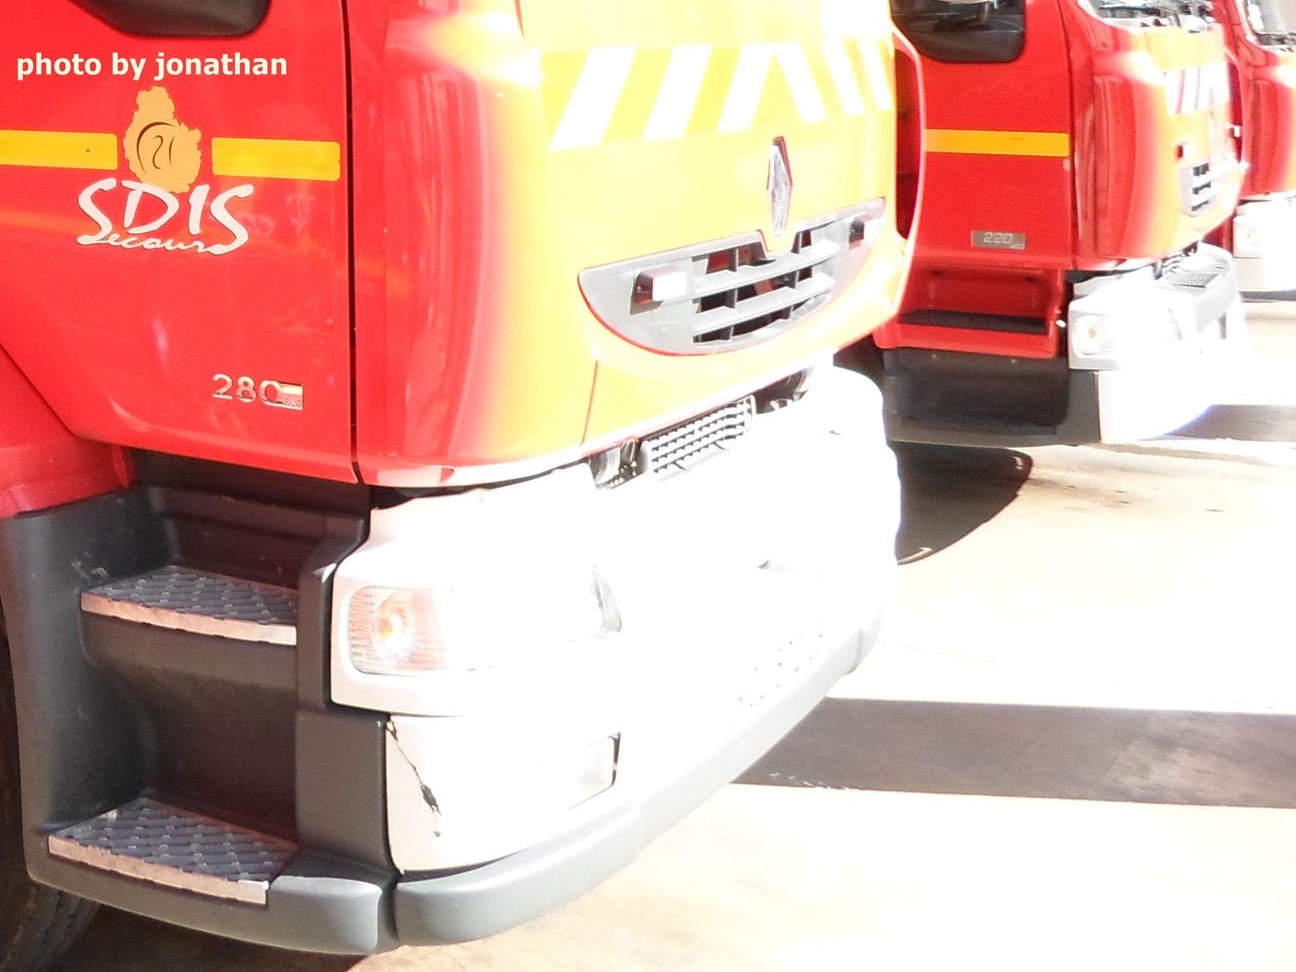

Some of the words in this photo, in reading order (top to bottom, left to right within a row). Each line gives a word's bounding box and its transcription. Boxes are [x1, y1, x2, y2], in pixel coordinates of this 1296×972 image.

[76, 178, 254, 255] SDIS
[983, 231, 1013, 244] 220
[212, 373, 280, 406] 280
